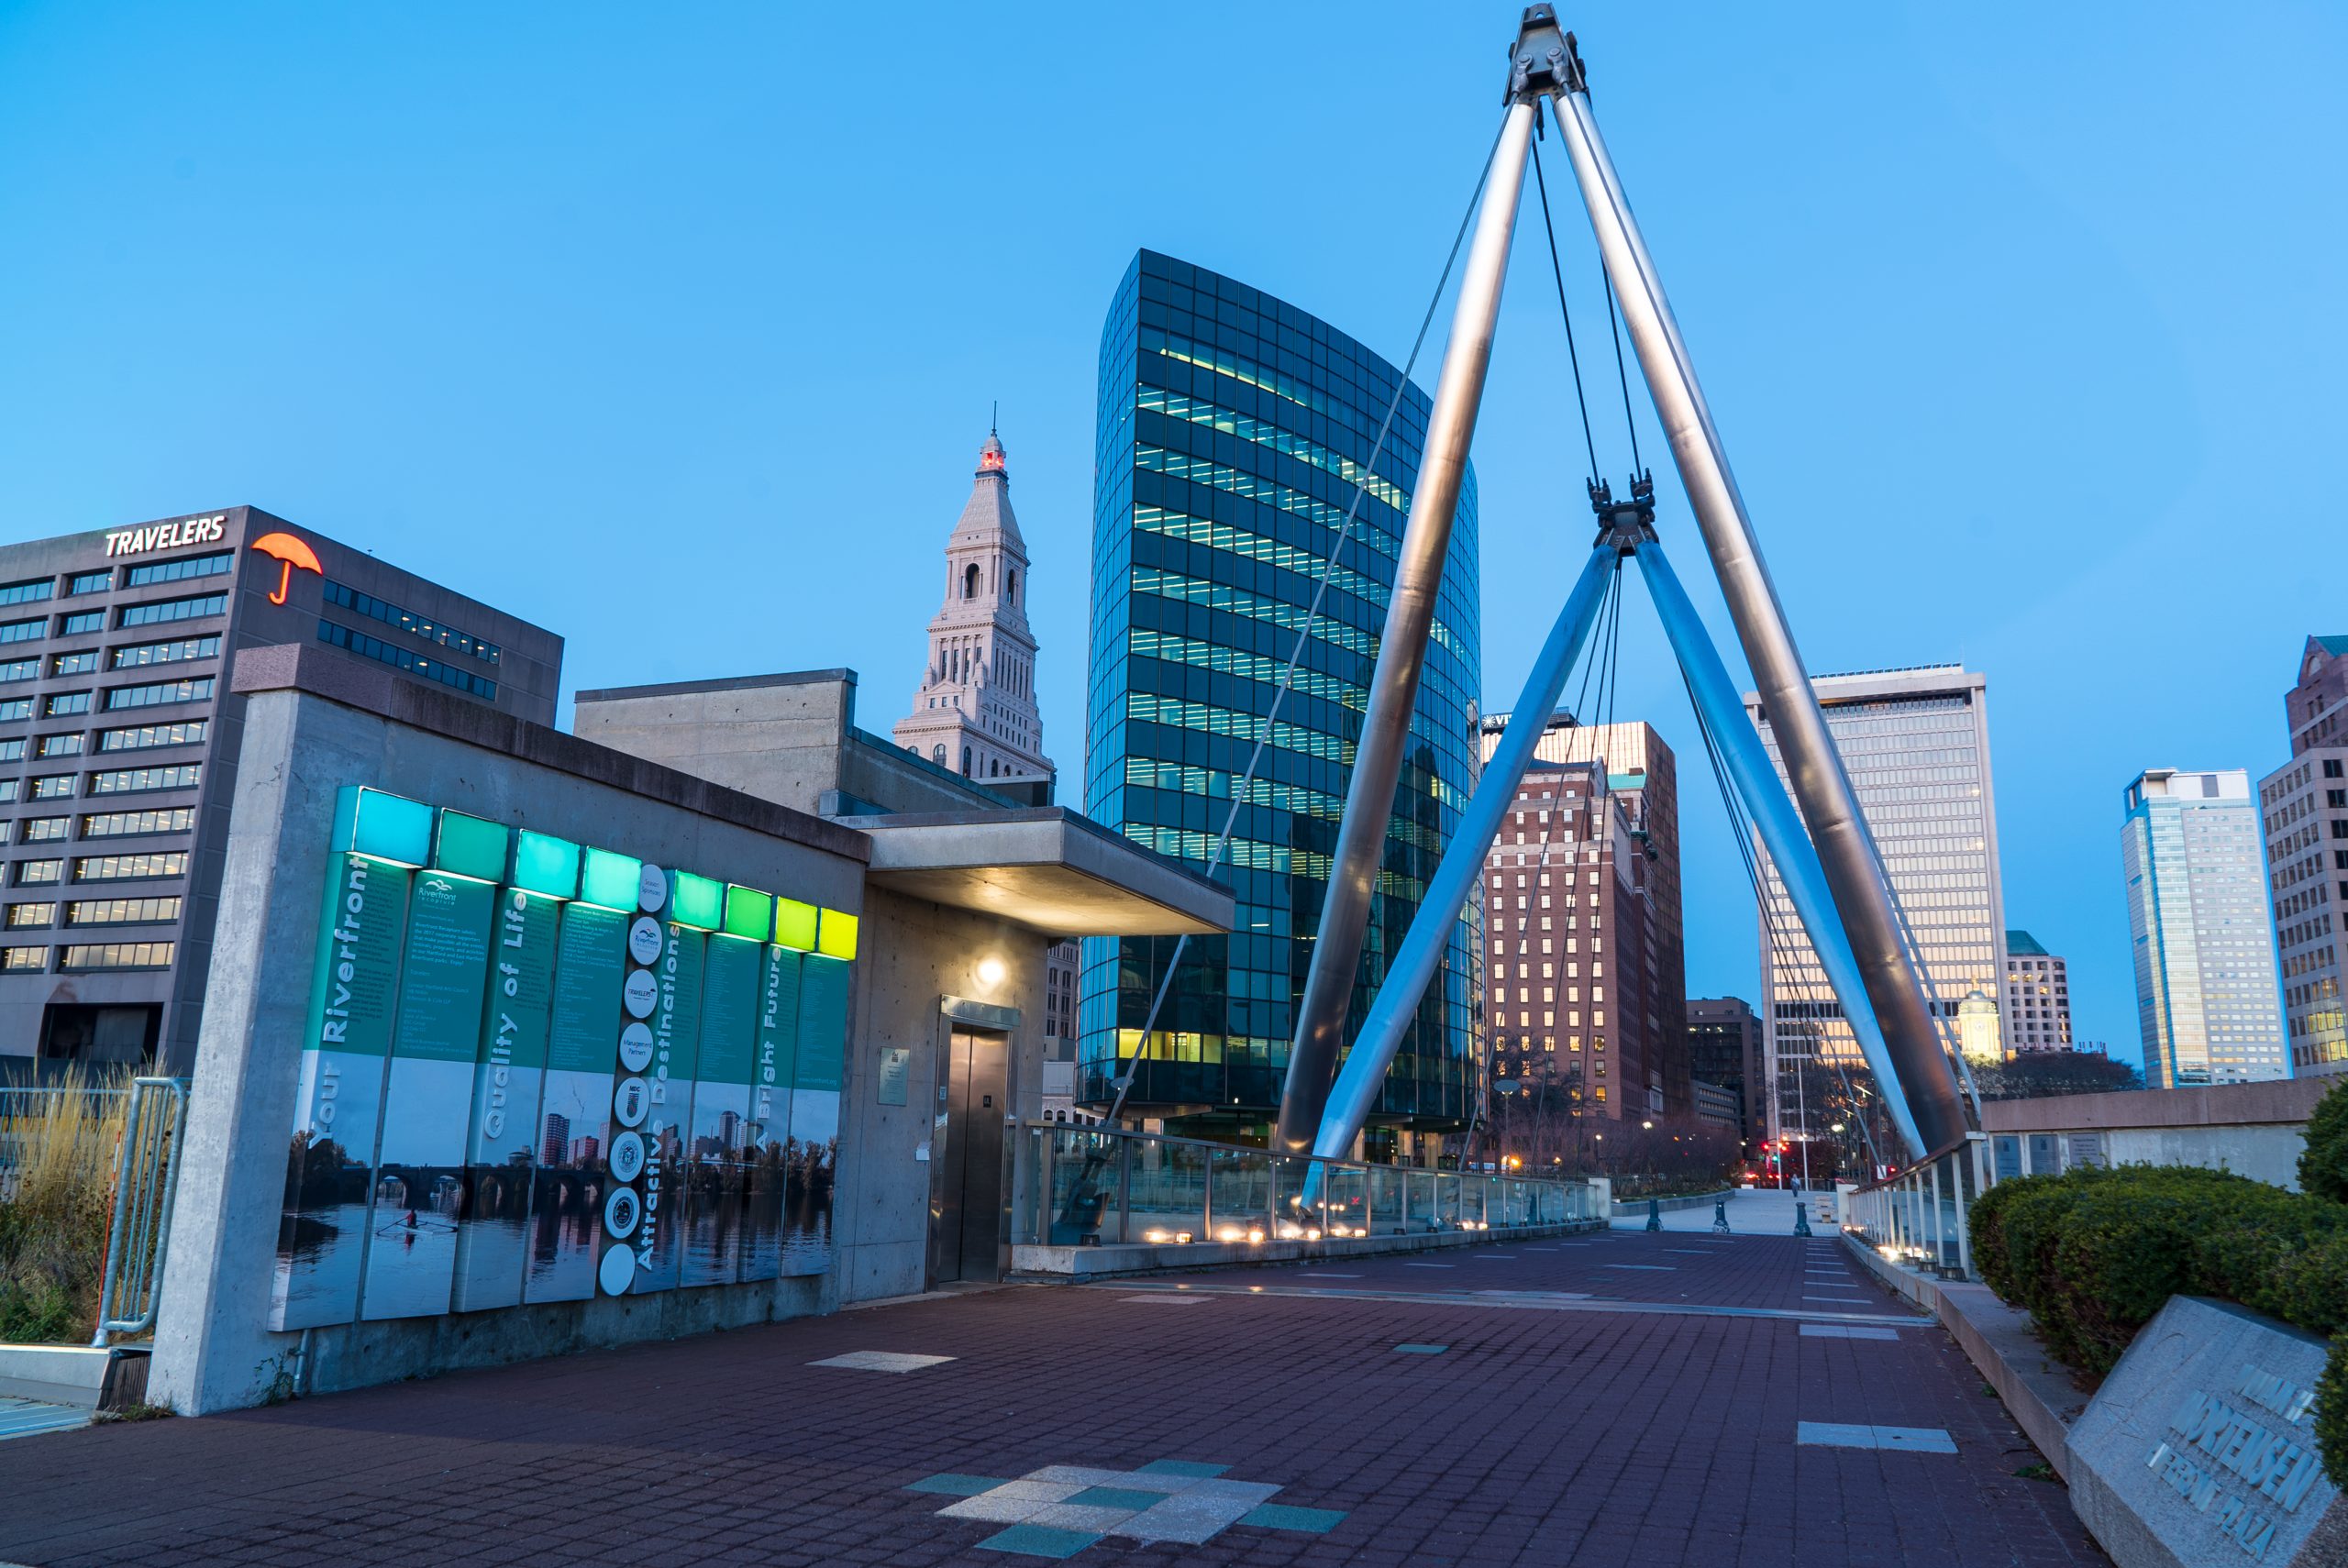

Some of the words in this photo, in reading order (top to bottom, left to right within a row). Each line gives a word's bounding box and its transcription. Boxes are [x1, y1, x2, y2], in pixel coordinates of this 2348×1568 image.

[105, 515, 227, 557] TRAVELERS
[1495, 713, 1512, 724] VI
[418, 888, 457, 900] Riverfront
[642, 886, 660, 897] Sponsors
[645, 879, 660, 888] Season
[504, 892, 526, 948] Life
[323, 856, 368, 1043] Riverfront
[635, 935, 659, 945] Riverfront
[500, 963, 519, 997] of
[627, 988, 651, 998] TRAVELERS
[764, 946, 781, 1028] Future
[624, 1040, 652, 1049] Management
[628, 1048, 646, 1056] Partners
[484, 1012, 517, 1139] Quality
[758, 1040, 775, 1119] Bright
[308, 1061, 340, 1150] Your
[638, 1120, 663, 1271] Attractive
[651, 924, 681, 1104] Destinations
[756, 1131, 768, 1152] A
[2169, 1390, 2322, 1513] MORTENSEN
[2216, 1496, 2276, 1561] PLAZA
